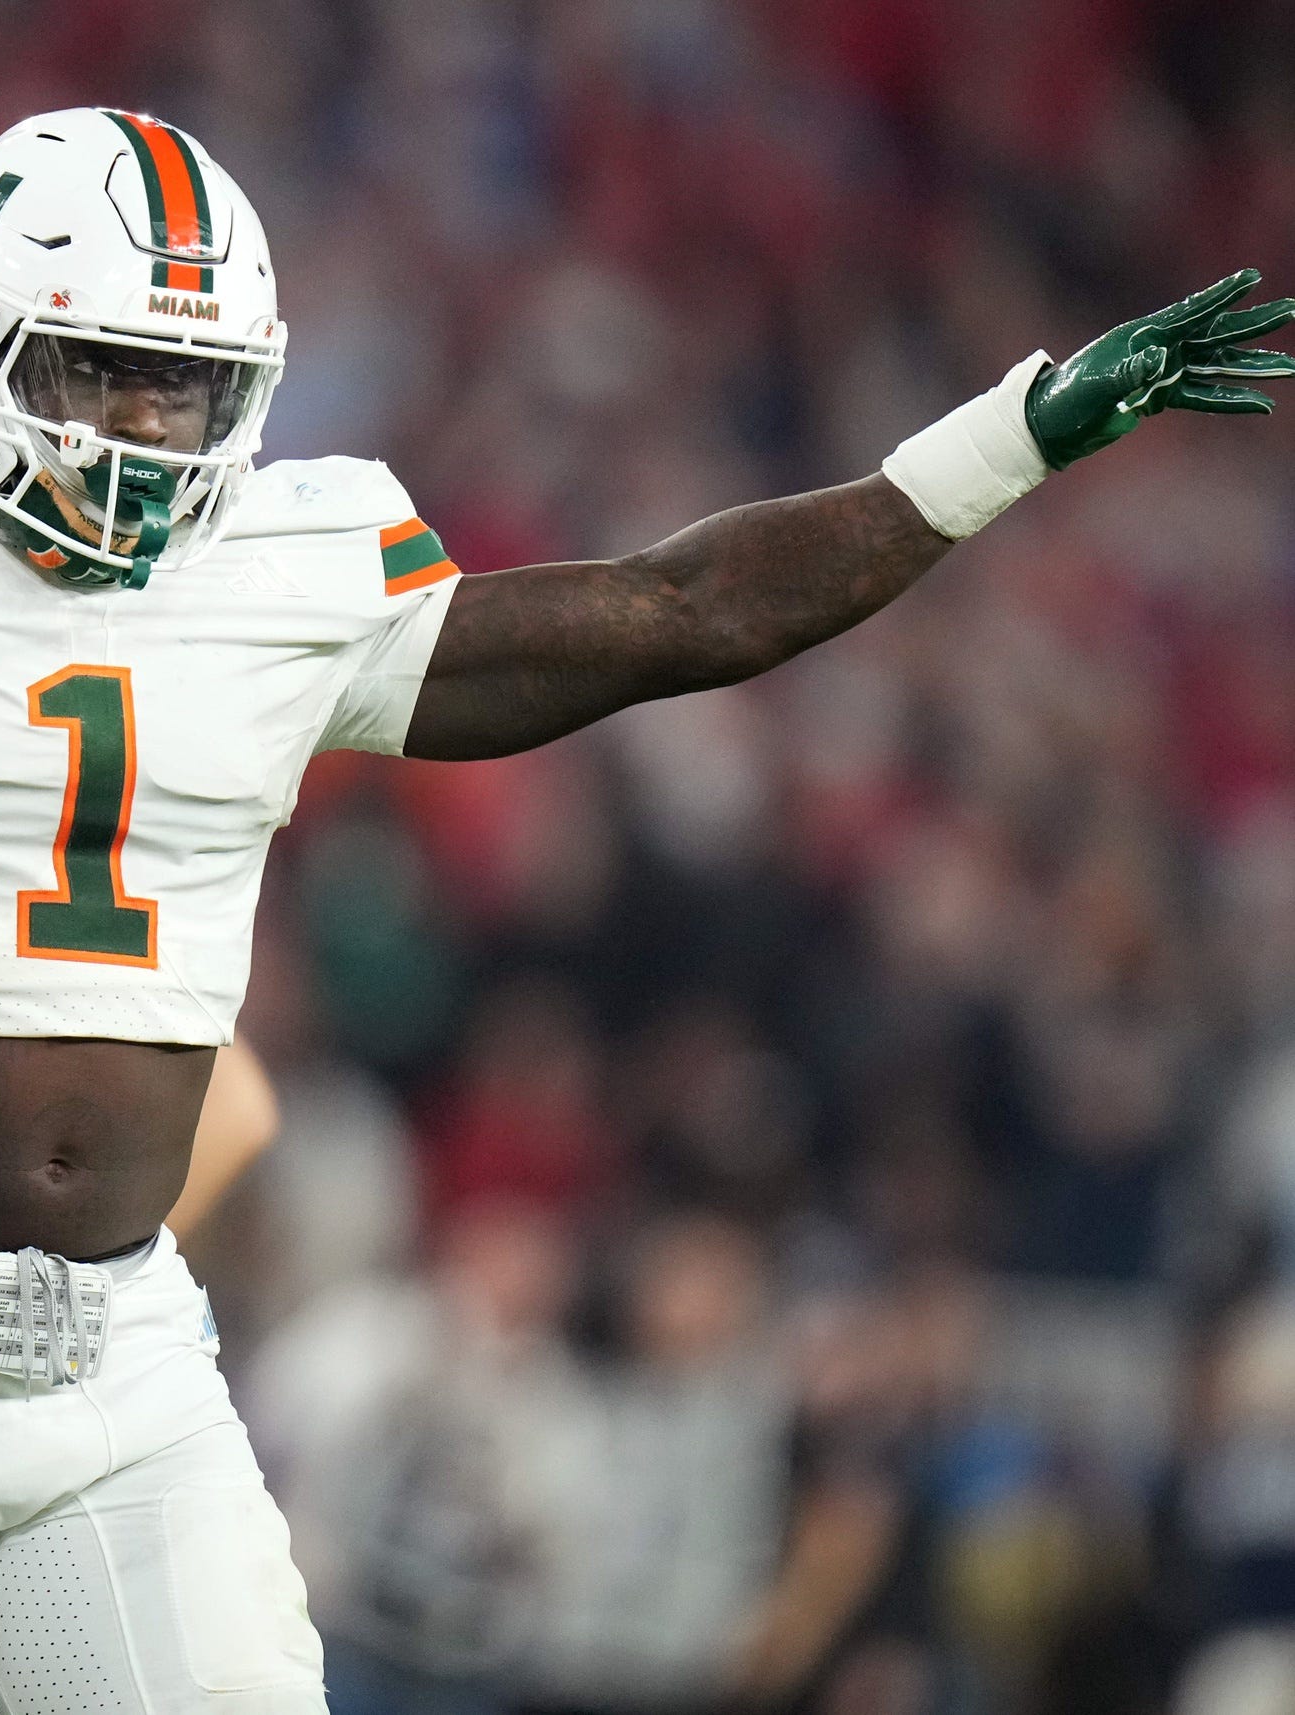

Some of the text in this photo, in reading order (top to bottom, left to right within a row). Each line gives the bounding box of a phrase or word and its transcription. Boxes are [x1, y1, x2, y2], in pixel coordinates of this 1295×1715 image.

[148, 293, 220, 322] MIAMI
[122, 466, 161, 480] SHOCK
[17, 663, 158, 970] 1
